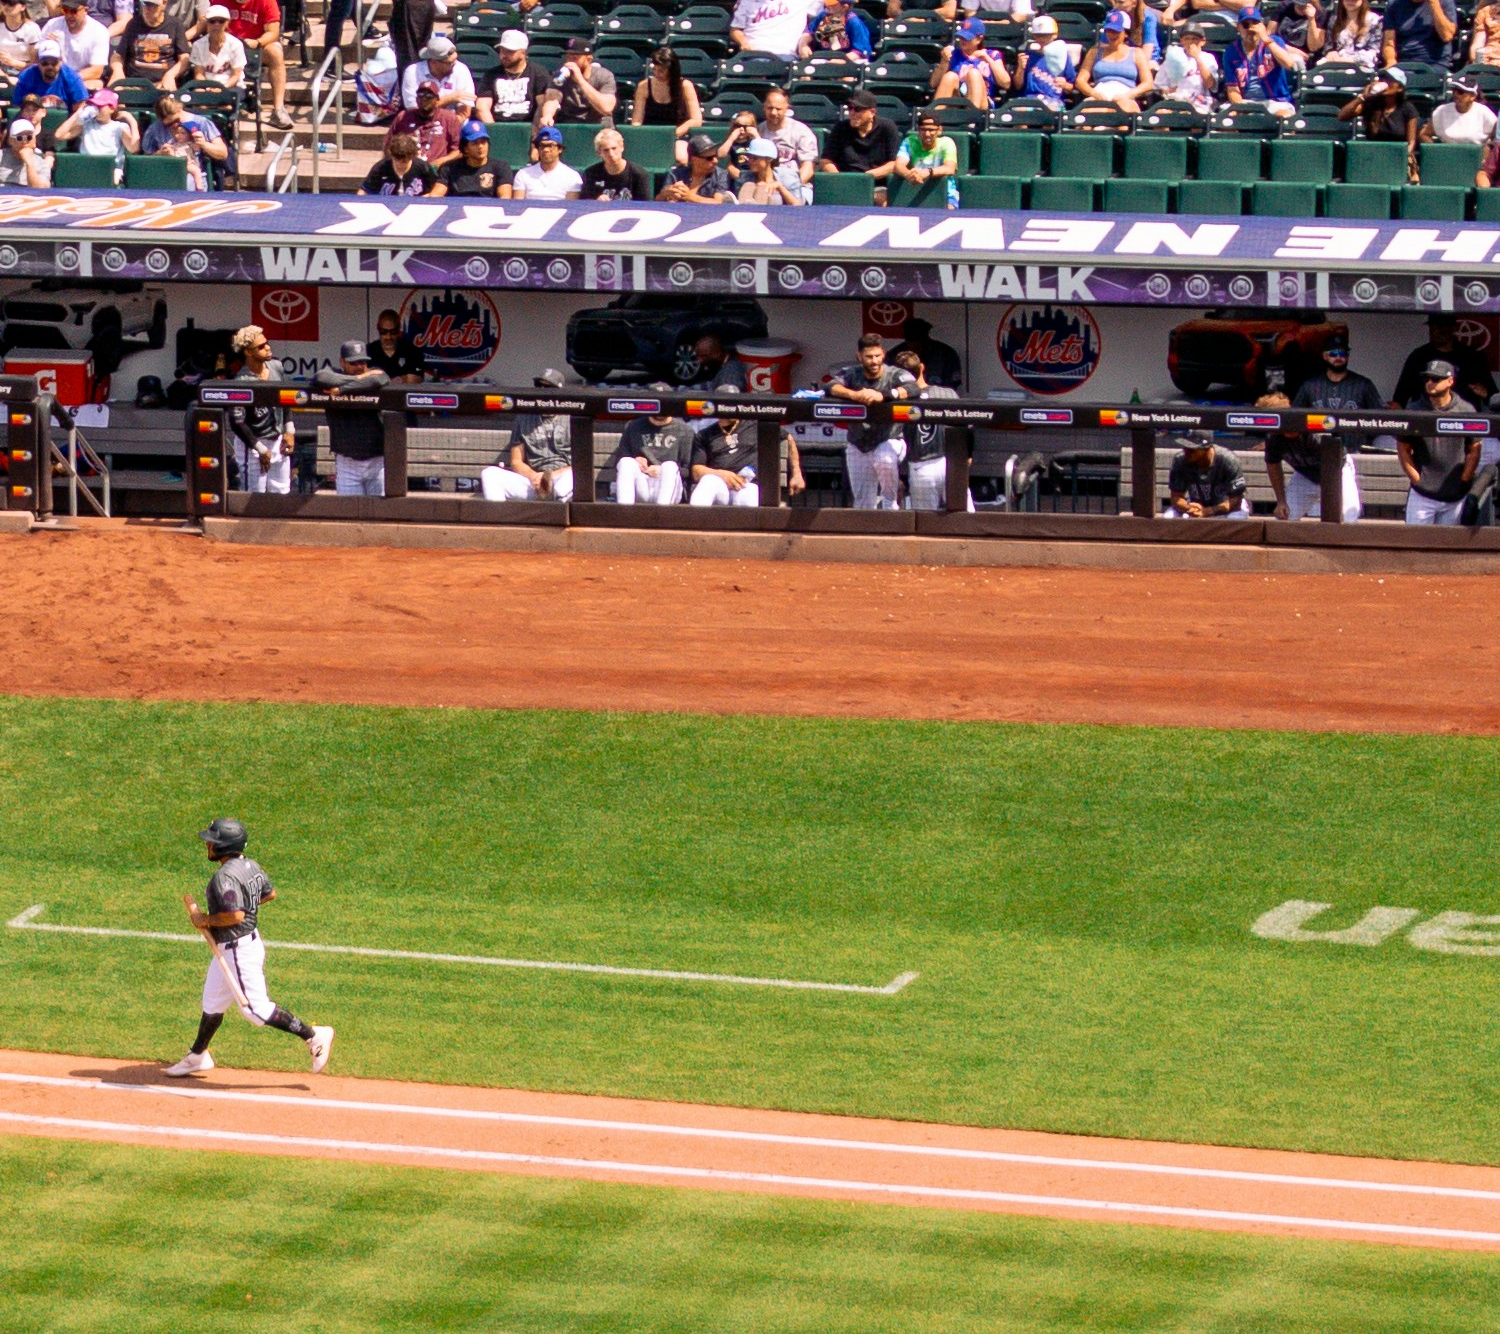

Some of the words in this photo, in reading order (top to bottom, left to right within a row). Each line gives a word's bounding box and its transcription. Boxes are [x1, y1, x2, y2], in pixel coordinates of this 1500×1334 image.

[753, 2, 789, 24] Mets
[315, 202, 783, 245] YORK
[819, 215, 1240, 257] NEW
[260, 246, 416, 284] WALK
[938, 264, 1100, 301] WALK
[413, 314, 483, 349] Mets
[1013, 330, 1084, 364] Mets
[350, 395, 379, 403] Lottery
[556, 400, 585, 409] Lottery
[757, 406, 786, 414] Lottery
[963, 410, 993, 419] Lottery
[1171, 414, 1201, 424] Lottery
[1359, 419, 1377, 427] York
[1378, 420, 1408, 429] Lottery
[641, 435, 677, 449] NYC
